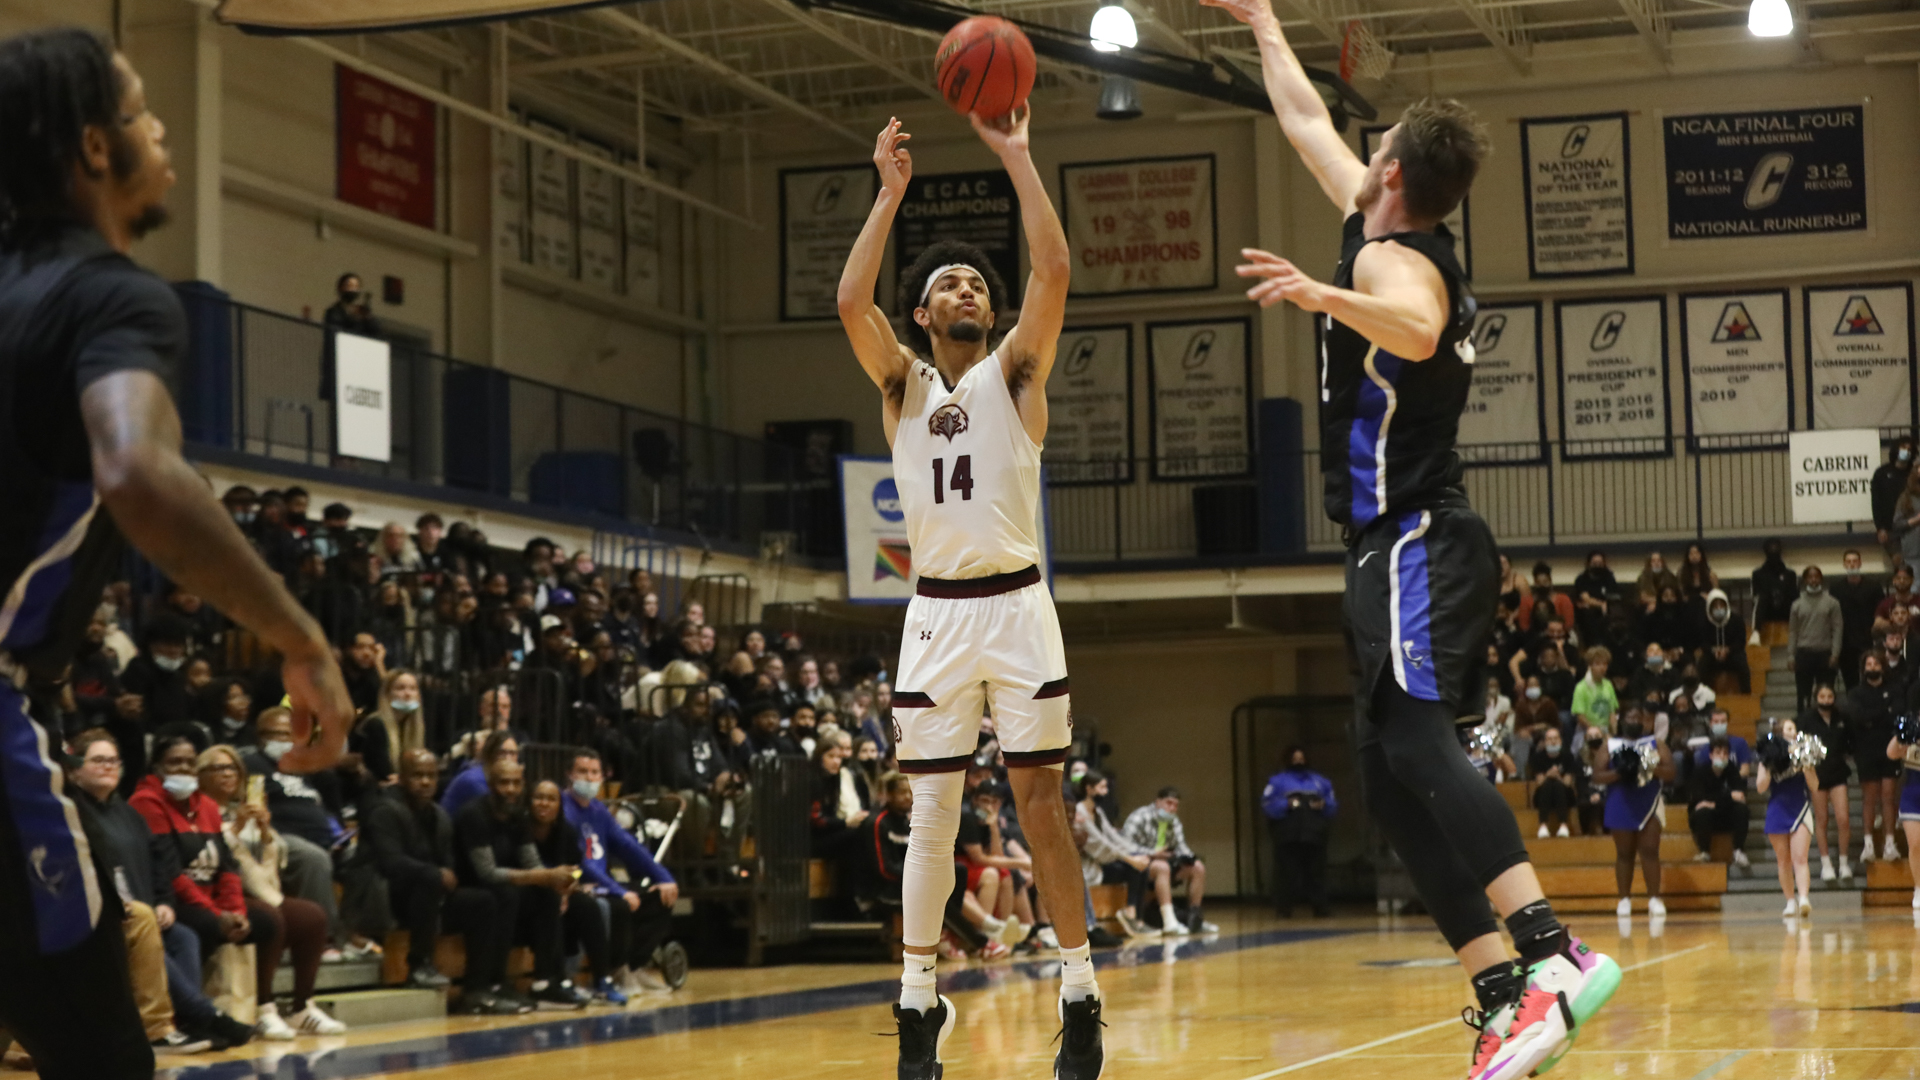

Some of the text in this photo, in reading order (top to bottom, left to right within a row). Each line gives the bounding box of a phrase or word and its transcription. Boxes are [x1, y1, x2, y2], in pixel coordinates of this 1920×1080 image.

[1672, 112, 1856, 135] NCAA FINAL FOUR
[1716, 131, 1815, 146] MEN'S BASKETBALL
[1538, 158, 1614, 173] NATIONAL
[1806, 163, 1849, 180] 31-2
[1138, 167, 1197, 185] COLLEGE
[1553, 171, 1602, 183] PLAYER
[1674, 168, 1745, 185] 2011-12
[1537, 180, 1618, 194] OF THE YEAR
[1684, 184, 1731, 197] SEASON
[1804, 179, 1853, 191] RECORD
[902, 197, 1010, 219] CHAMPIONS
[1092, 215, 1116, 234] 19
[1165, 209, 1191, 230] 98
[1674, 212, 1862, 236] NATIONAL RUNNER-UP
[1082, 241, 1201, 268] CHAMPIONS
[1726, 347, 1749, 357] MEN
[1836, 343, 1884, 353] OVERALL
[1586, 357, 1632, 367] OVERALL
[1814, 357, 1908, 368] COMMISSIONER'S
[1567, 366, 1657, 384] PRESIDENT'S
[1727, 374, 1750, 384] CUP
[1849, 369, 1873, 379] CUP
[1600, 382, 1625, 393] CUP
[1821, 384, 1859, 397] 2019
[1700, 389, 1736, 402] 2019
[1464, 402, 1487, 413] 018
[1575, 407, 1655, 425] 2017 2018
[1803, 455, 1869, 473] CABRINI
[932, 454, 974, 505] 14
[1795, 478, 1872, 497] STUDENT
